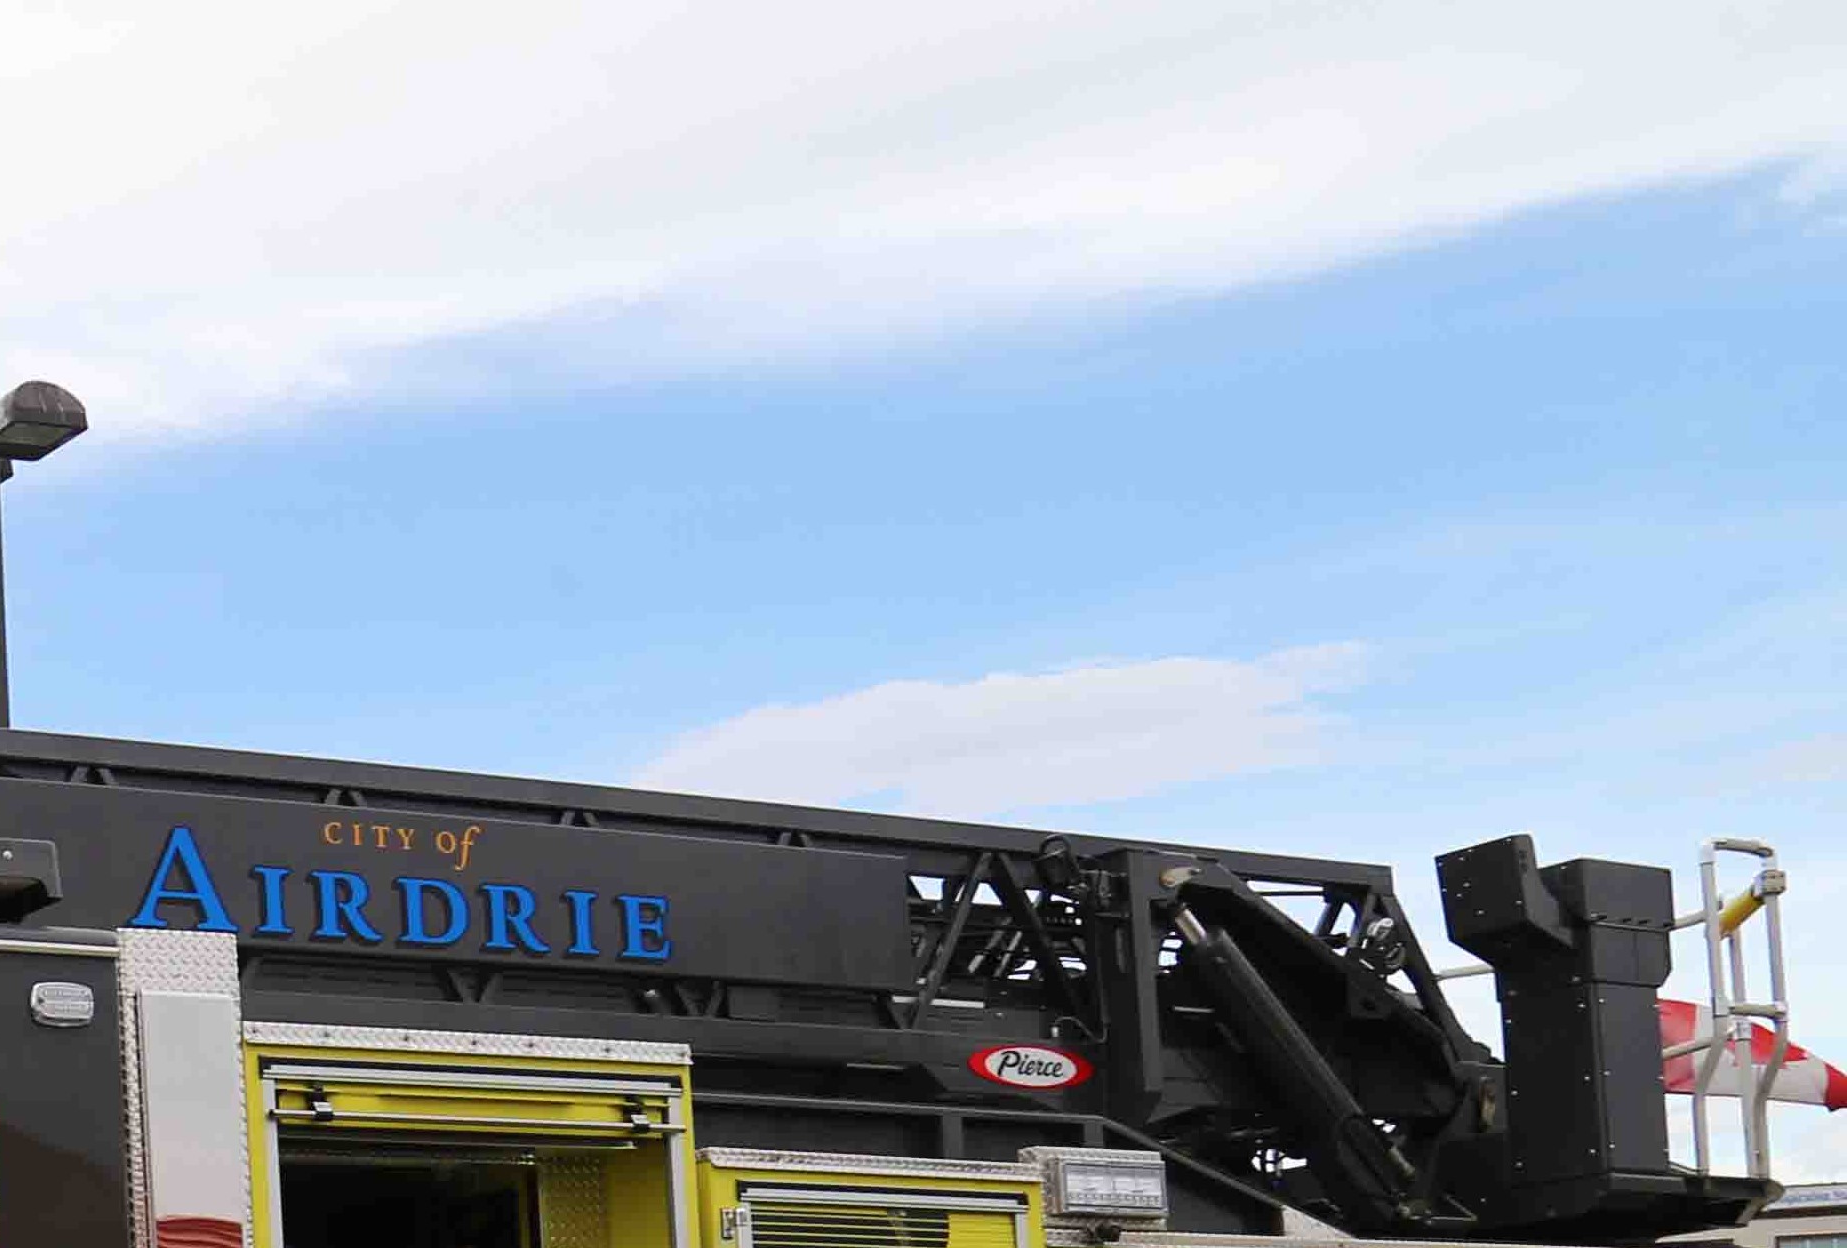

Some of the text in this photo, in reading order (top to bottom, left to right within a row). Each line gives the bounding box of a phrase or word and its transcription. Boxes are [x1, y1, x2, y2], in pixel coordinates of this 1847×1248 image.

[323, 820, 481, 871] CITY of
[126, 825, 672, 960] AIRDRIE
[997, 1050, 1064, 1078] Pierce
